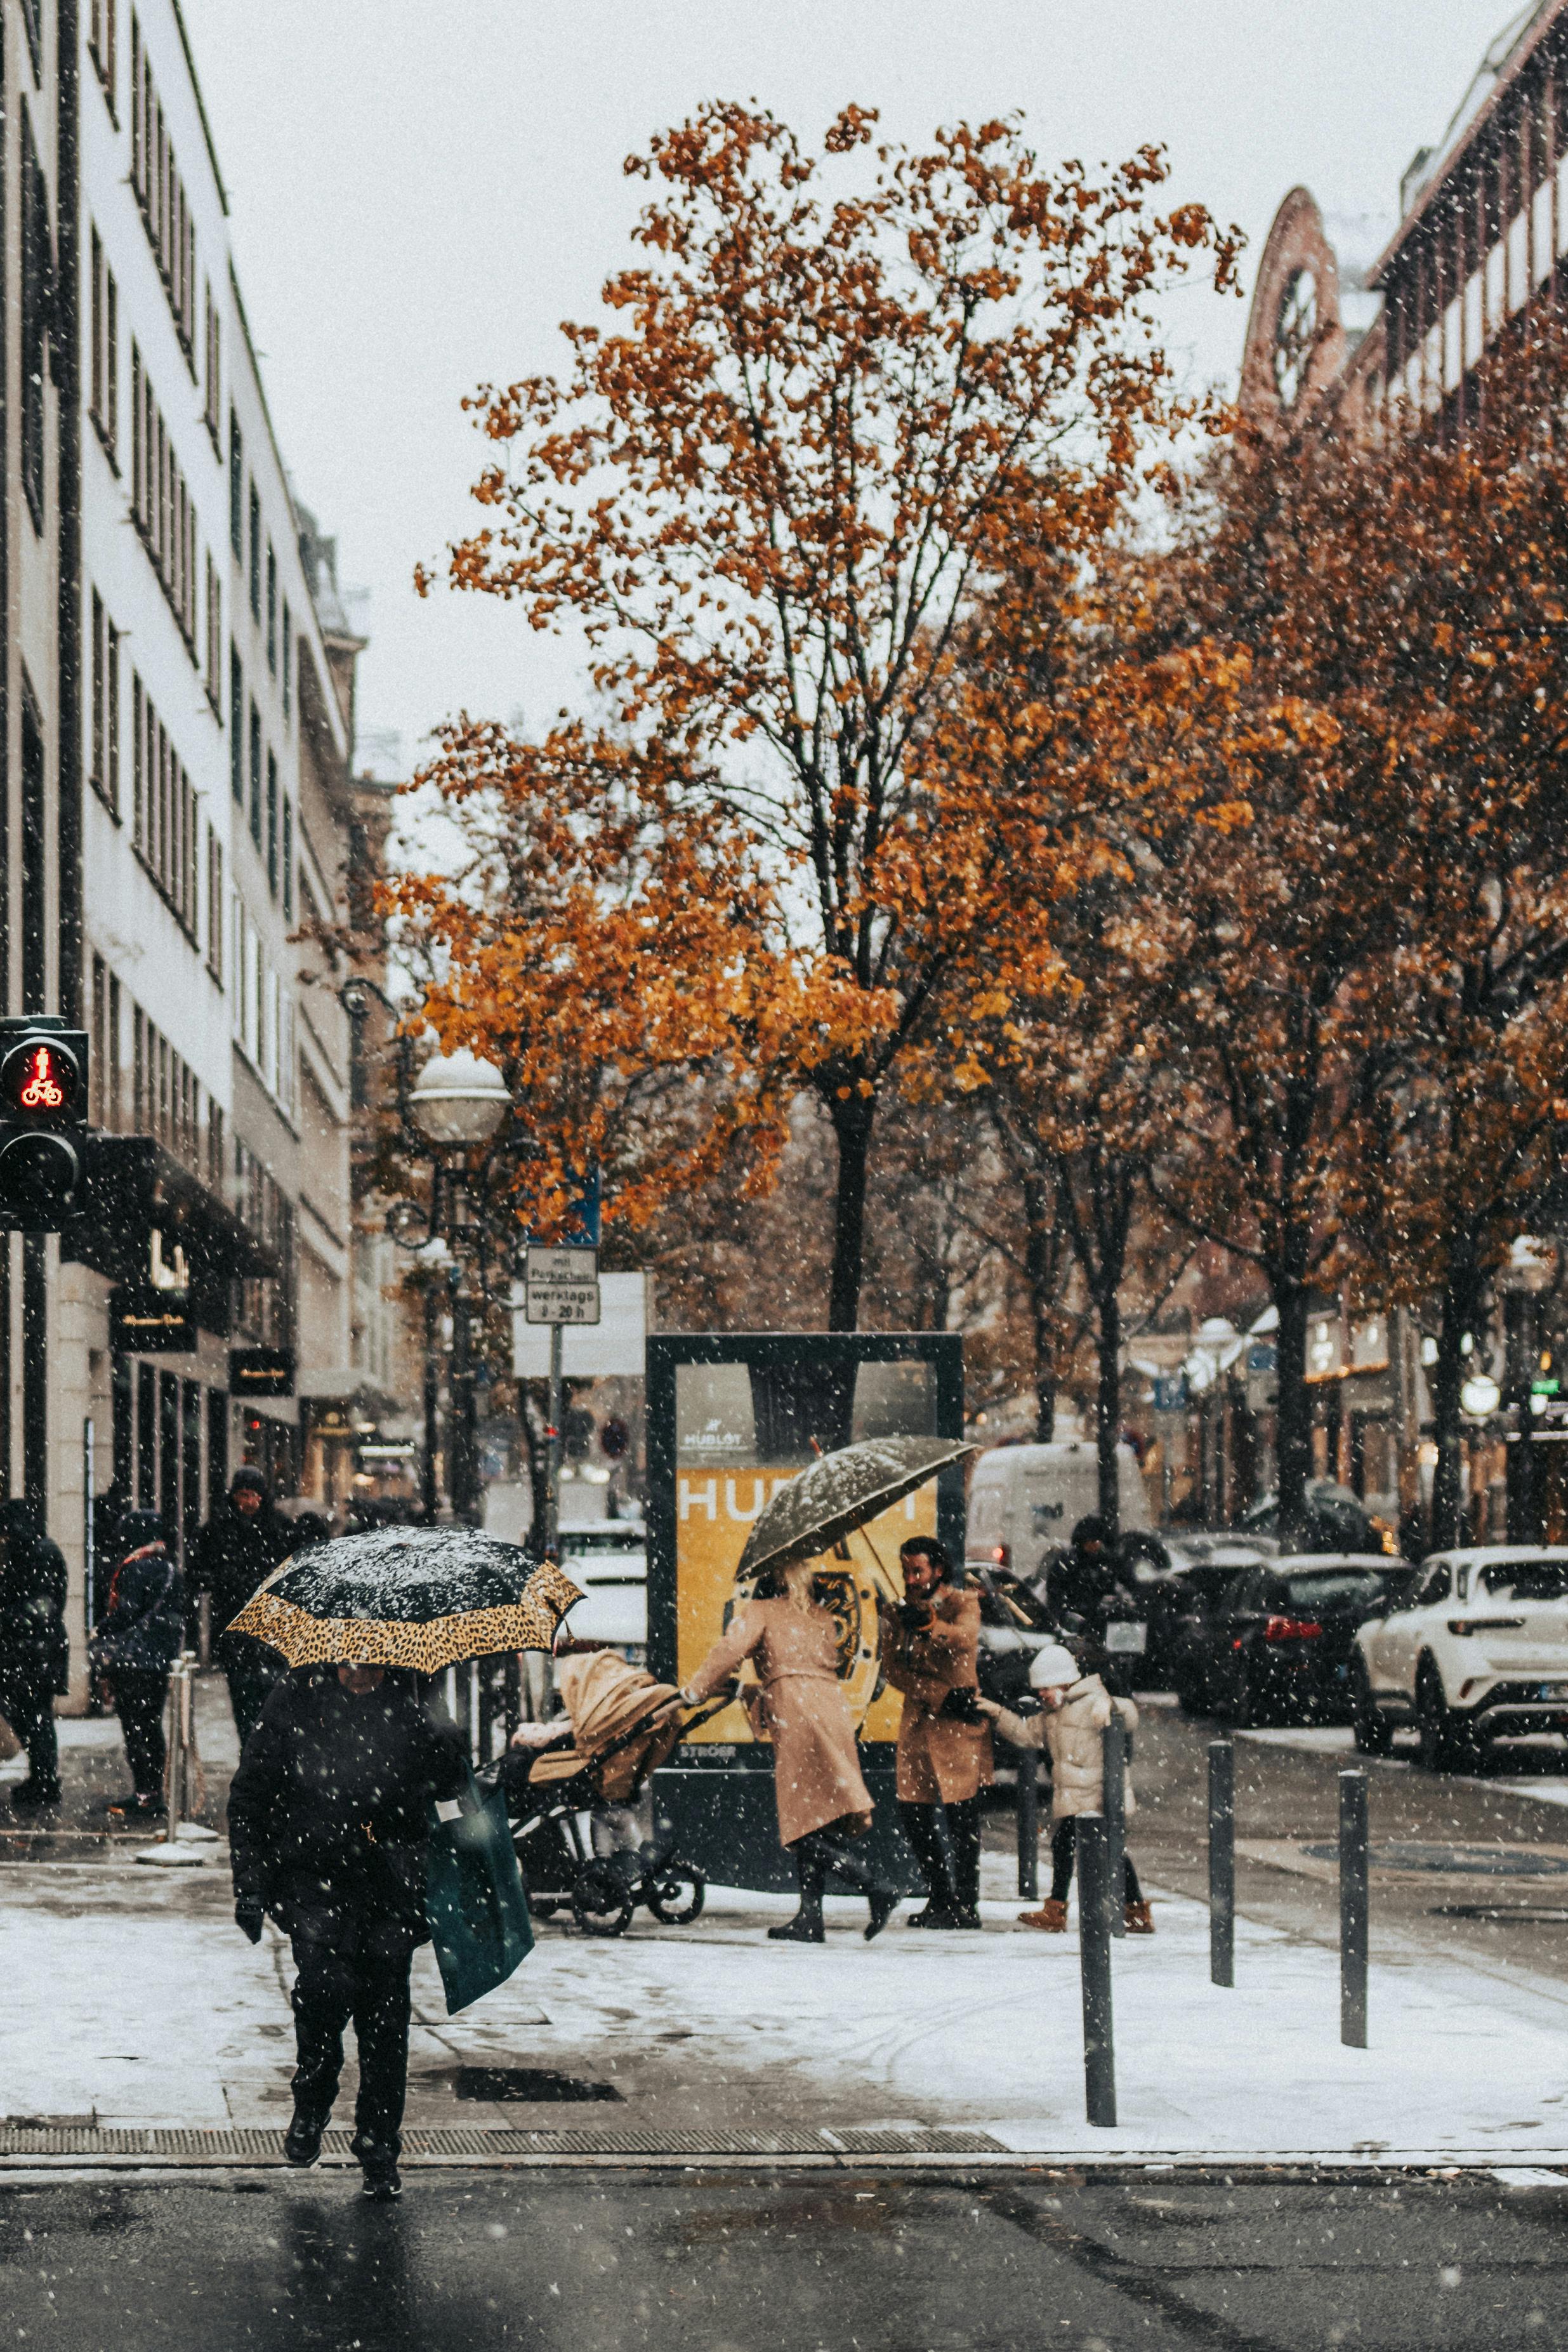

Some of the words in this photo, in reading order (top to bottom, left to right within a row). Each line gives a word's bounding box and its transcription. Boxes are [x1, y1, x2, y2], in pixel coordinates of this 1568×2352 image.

[531, 1290, 594, 1304] werktags
[559, 1305, 572, 1318] 20
[576, 1305, 584, 1318] h
[685, 1433, 741, 1444] HUBLOT
